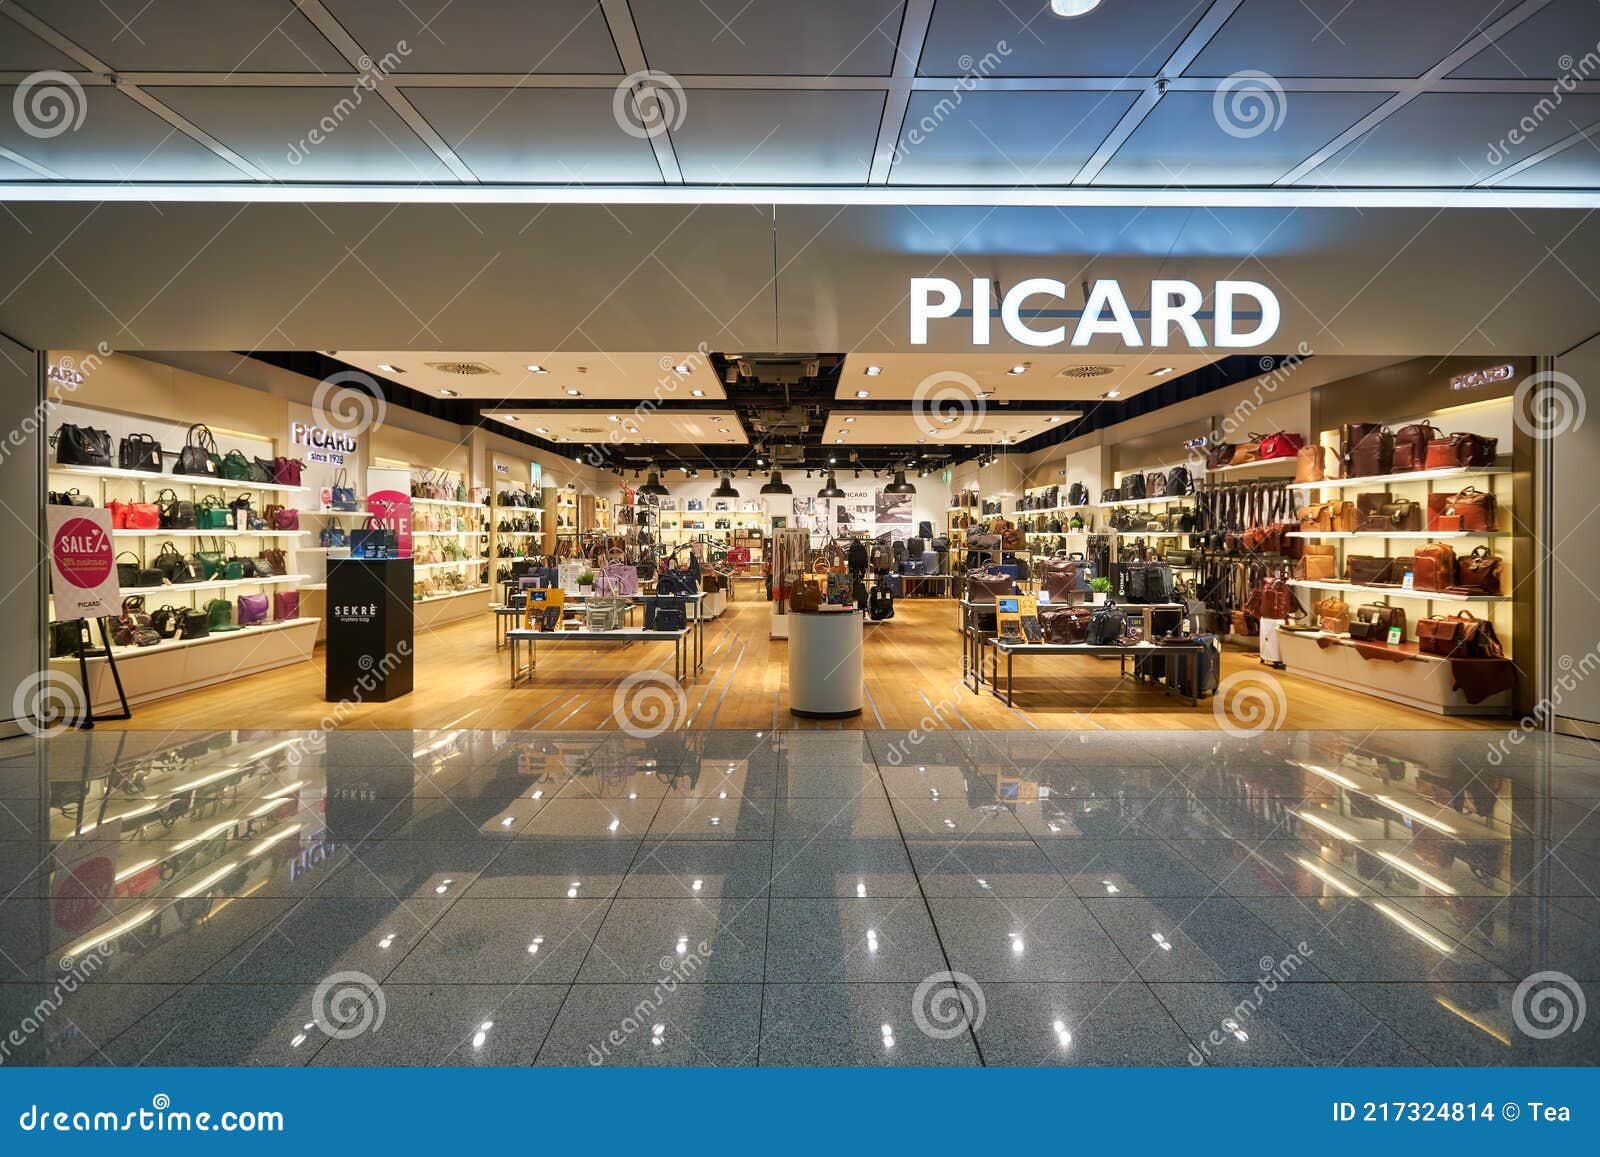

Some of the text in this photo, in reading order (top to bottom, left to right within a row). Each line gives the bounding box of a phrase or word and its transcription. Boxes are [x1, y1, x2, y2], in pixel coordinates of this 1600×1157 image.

[910, 277, 1281, 347] PICARD
[48, 365, 85, 385] ARD
[292, 423, 357, 453] PICARD
[310, 452, 327, 462] since
[61, 535, 93, 553] SALE
[334, 603, 377, 615] SEKRÈ
